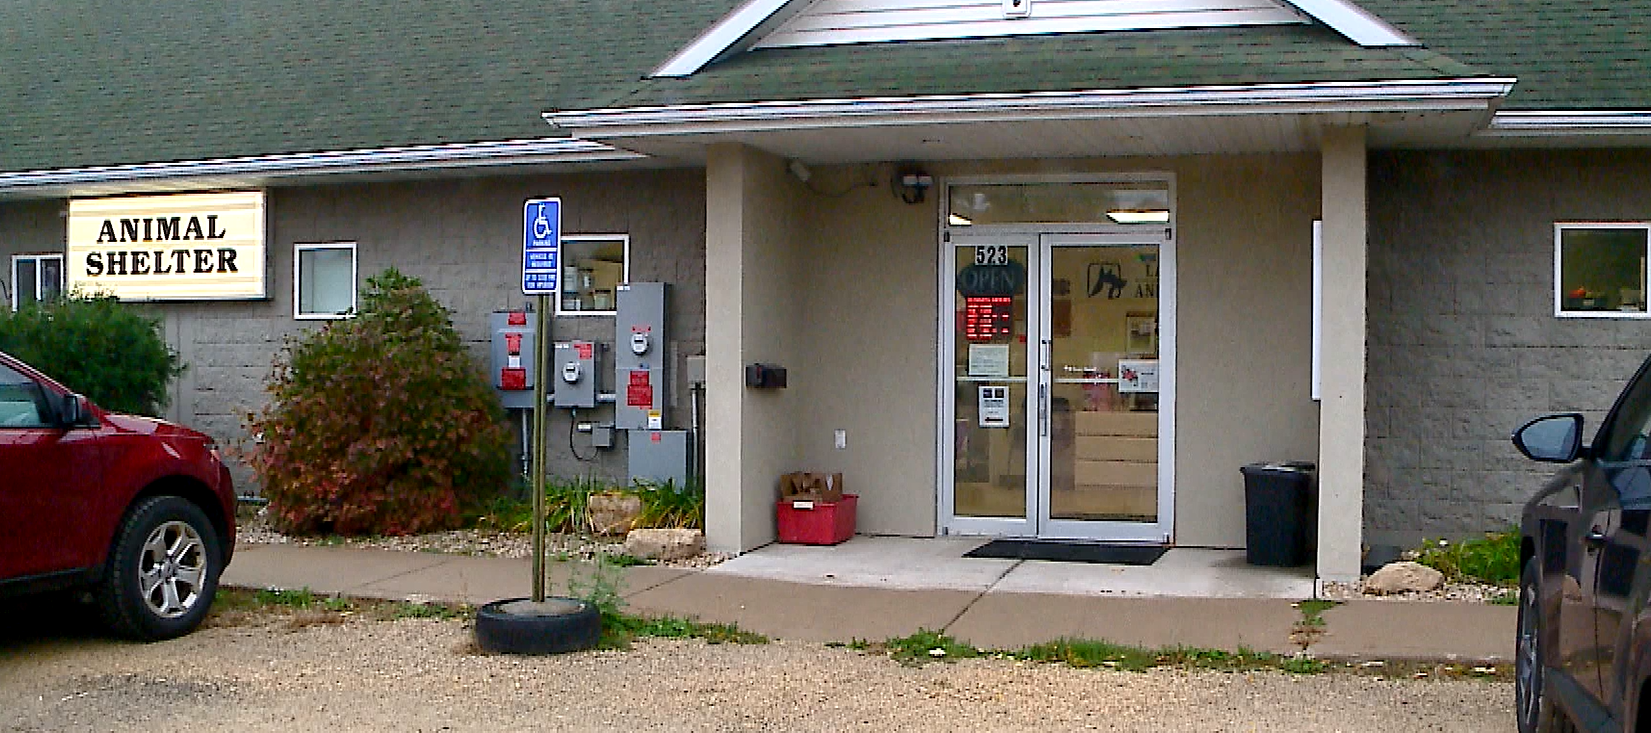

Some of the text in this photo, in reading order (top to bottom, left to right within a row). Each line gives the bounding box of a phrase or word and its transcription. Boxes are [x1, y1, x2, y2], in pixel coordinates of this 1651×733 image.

[96, 215, 227, 243] ANIMAL
[86, 247, 239, 277] SHELTER
[976, 245, 1007, 264] 523
[962, 269, 1014, 290] OPEN
